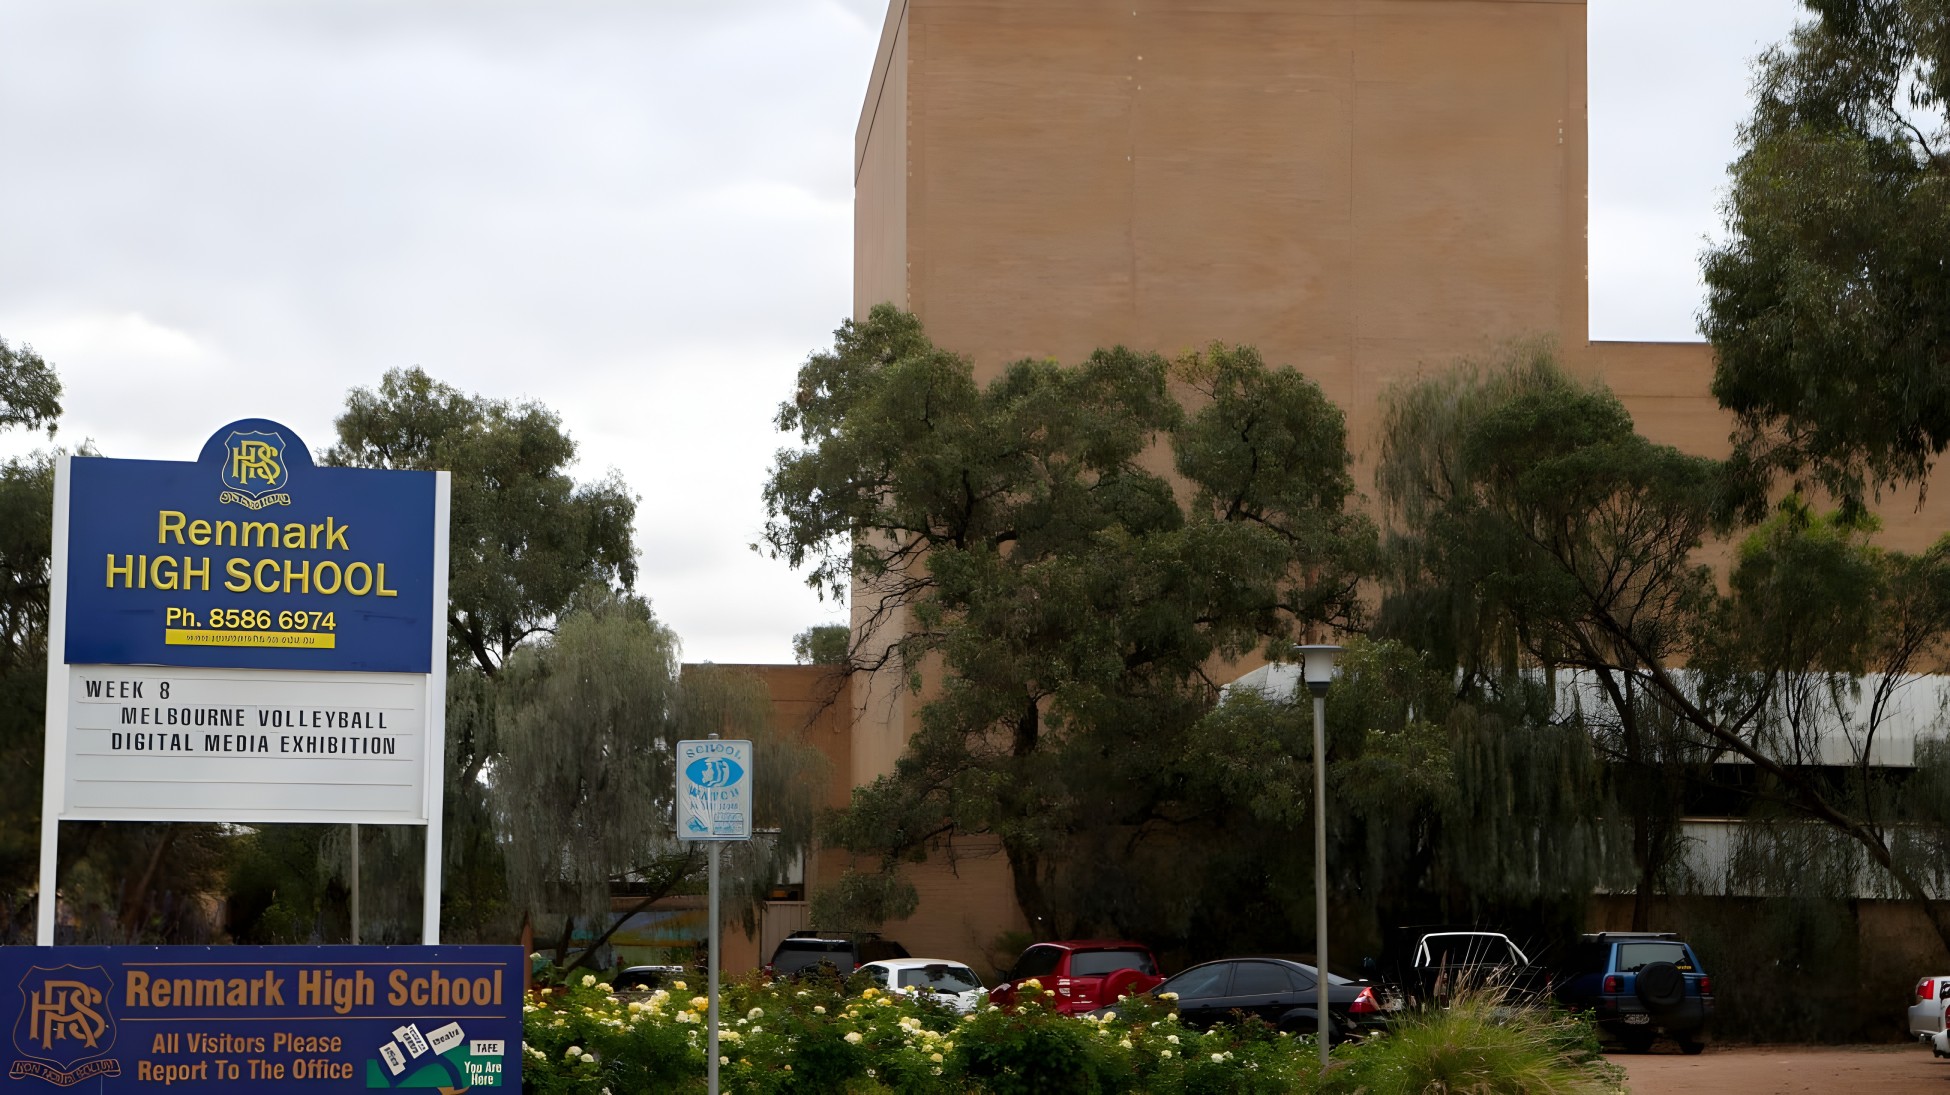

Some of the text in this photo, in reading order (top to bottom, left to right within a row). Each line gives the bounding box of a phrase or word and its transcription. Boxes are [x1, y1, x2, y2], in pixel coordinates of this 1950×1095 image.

[158, 510, 350, 551] Renmark
[106, 553, 398, 597] HIGH SCHOOL
[166, 607, 337, 631] Ph. 8586 6974
[86, 680, 170, 700] WEEK 8
[121, 707, 388, 729] MELBOURNE VOLLEYBALL
[111, 732, 395, 755] DIGITAL MEDIA EXHIBITION
[126, 968, 504, 1015] Renmark High School
[151, 1032, 343, 1055] All Visitors Please
[476, 1043, 499, 1053] TAFE
[137, 1059, 209, 1086] Report
[215, 1059, 240, 1081] To
[246, 1059, 286, 1081] The
[292, 1058, 354, 1080] Office
[464, 1061, 502, 1074] You Are
[471, 1073, 494, 1086] Here
